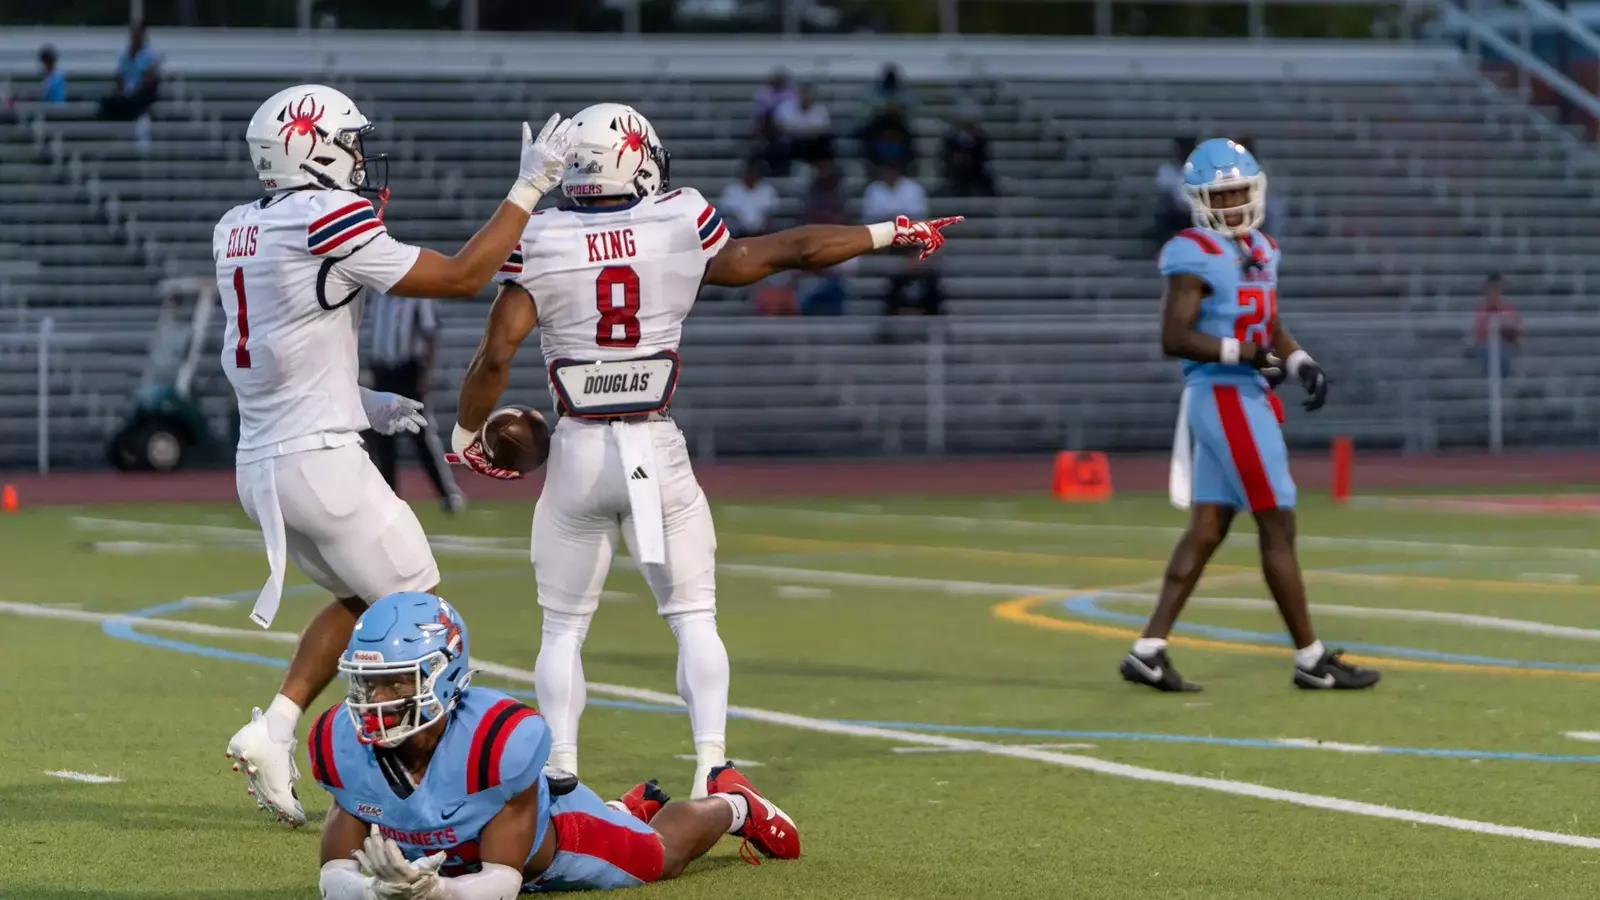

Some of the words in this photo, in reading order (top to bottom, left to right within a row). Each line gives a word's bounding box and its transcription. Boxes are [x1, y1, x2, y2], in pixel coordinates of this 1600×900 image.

[566, 184, 602, 195] SPIDERS
[226, 226, 259, 258] ELLIS
[586, 229, 636, 262] KING
[234, 267, 251, 368] 1
[596, 265, 640, 348] 8
[584, 372, 650, 394] DOUGLAS
